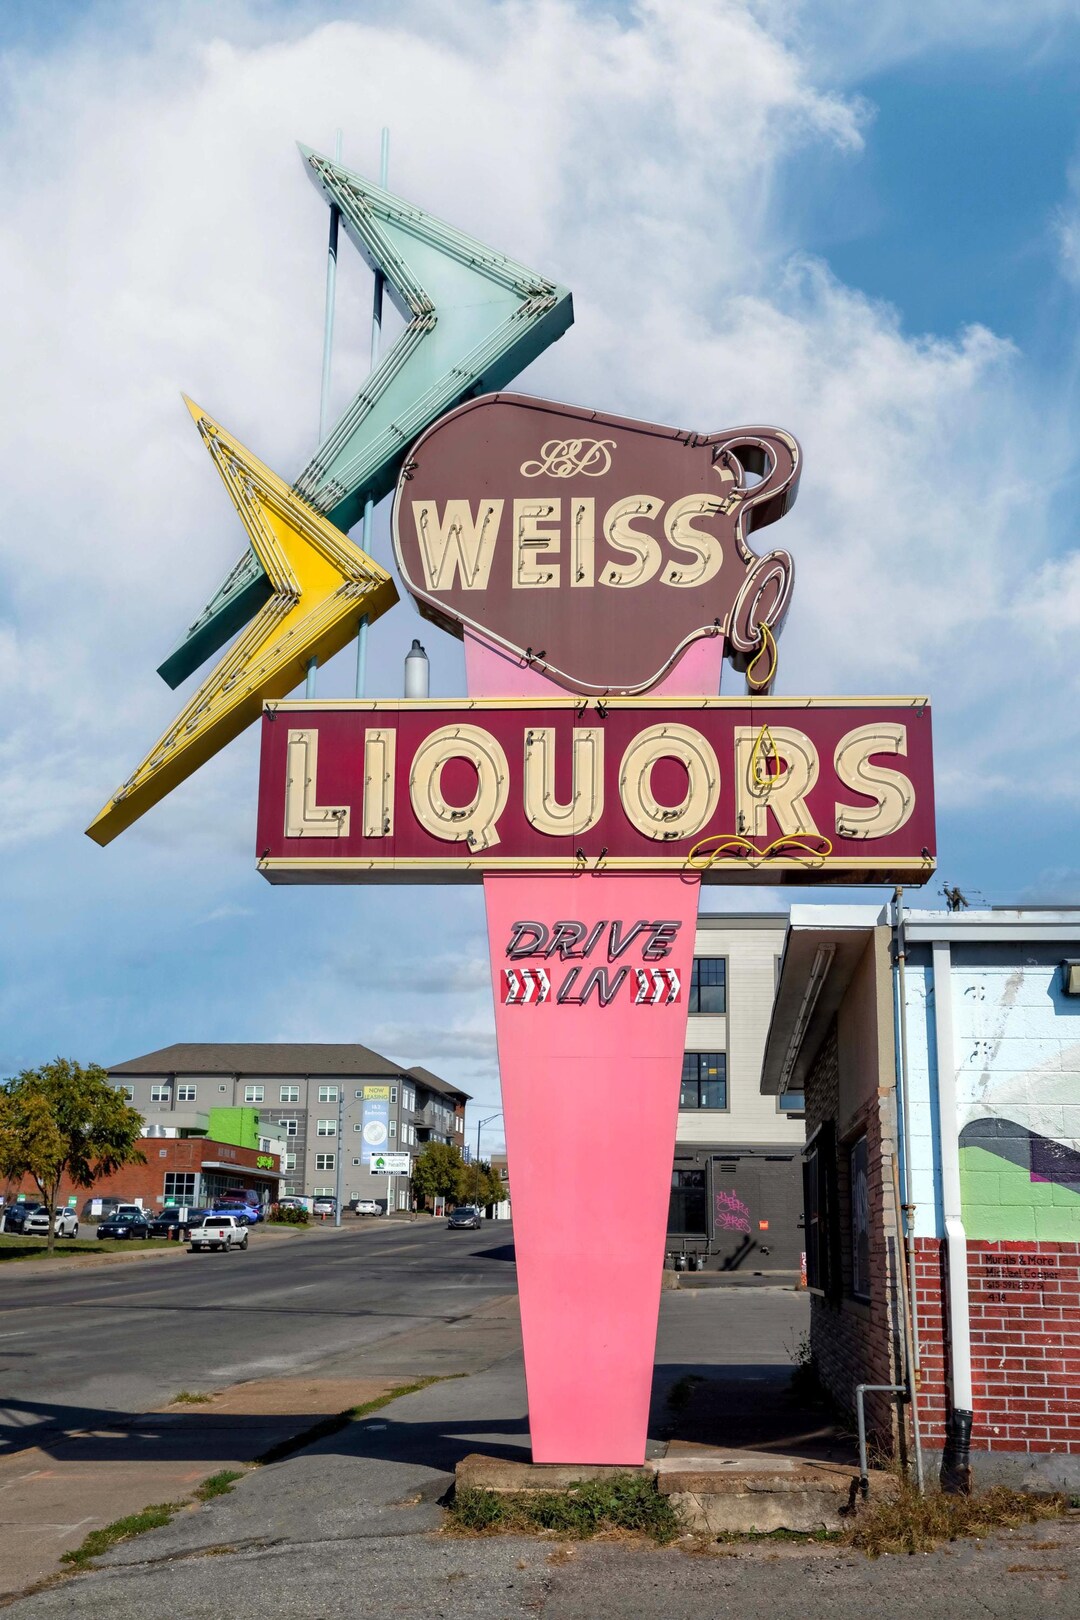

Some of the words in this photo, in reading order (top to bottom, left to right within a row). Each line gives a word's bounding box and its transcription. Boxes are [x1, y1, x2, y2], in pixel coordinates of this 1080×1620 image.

[411, 493, 725, 591] WEISS
[286, 722, 915, 852] LIQUORS
[506, 920, 682, 960] DRIVE
[556, 966, 632, 1005] IN
[985, 1254, 1016, 1265] Murals
[1018, 1254, 1026, 1266] &
[1027, 1255, 1054, 1266] More
[1023, 1268, 1059, 1280] Cooper
